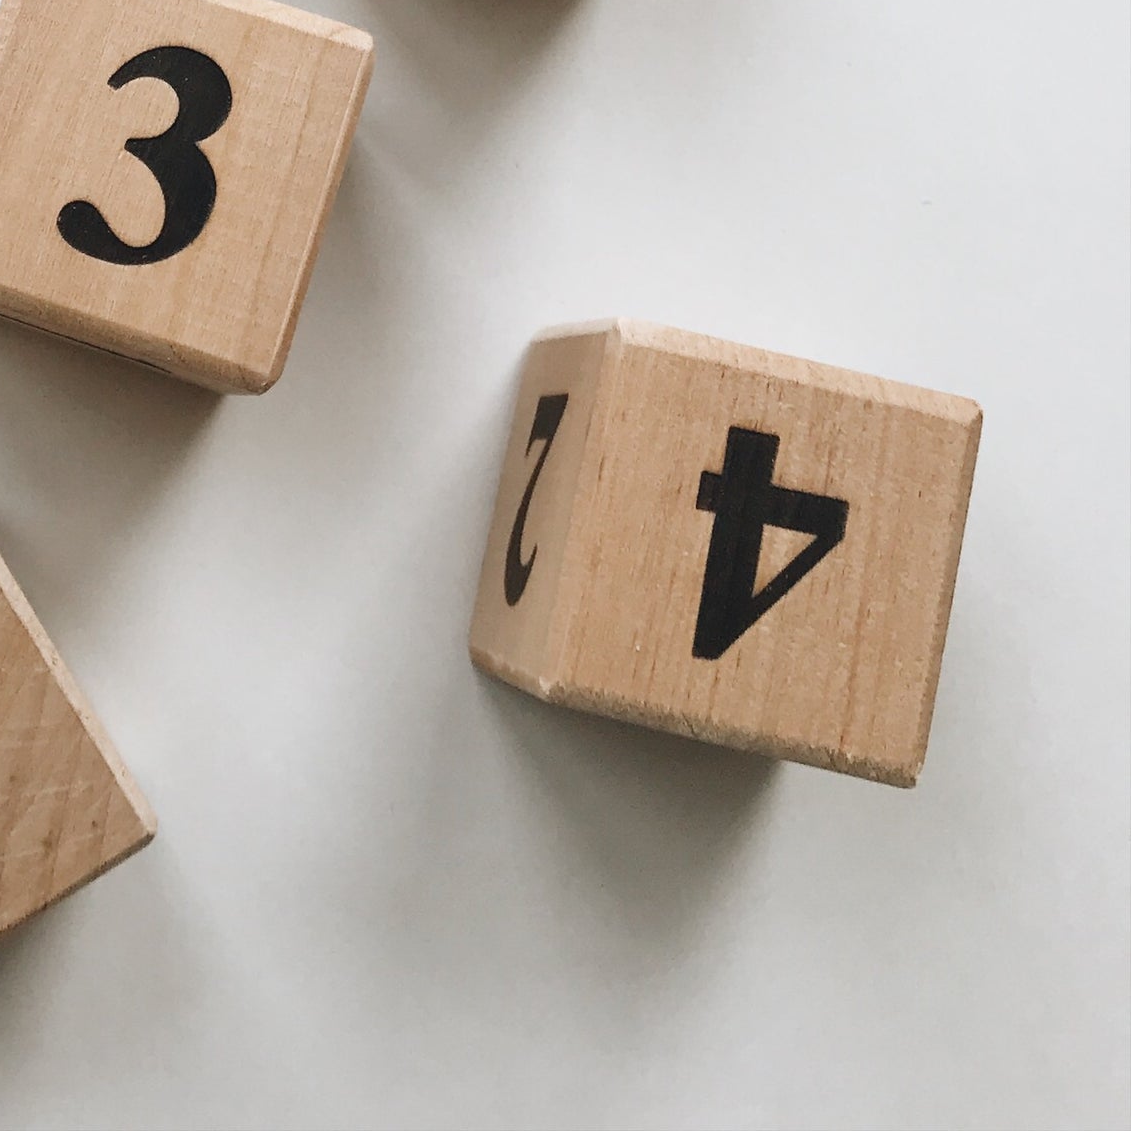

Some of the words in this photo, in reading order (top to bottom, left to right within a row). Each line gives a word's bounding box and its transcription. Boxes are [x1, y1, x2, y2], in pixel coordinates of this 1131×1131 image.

[57, 46, 232, 265] 3
[503, 393, 569, 607] 2
[692, 426, 849, 660] 4
